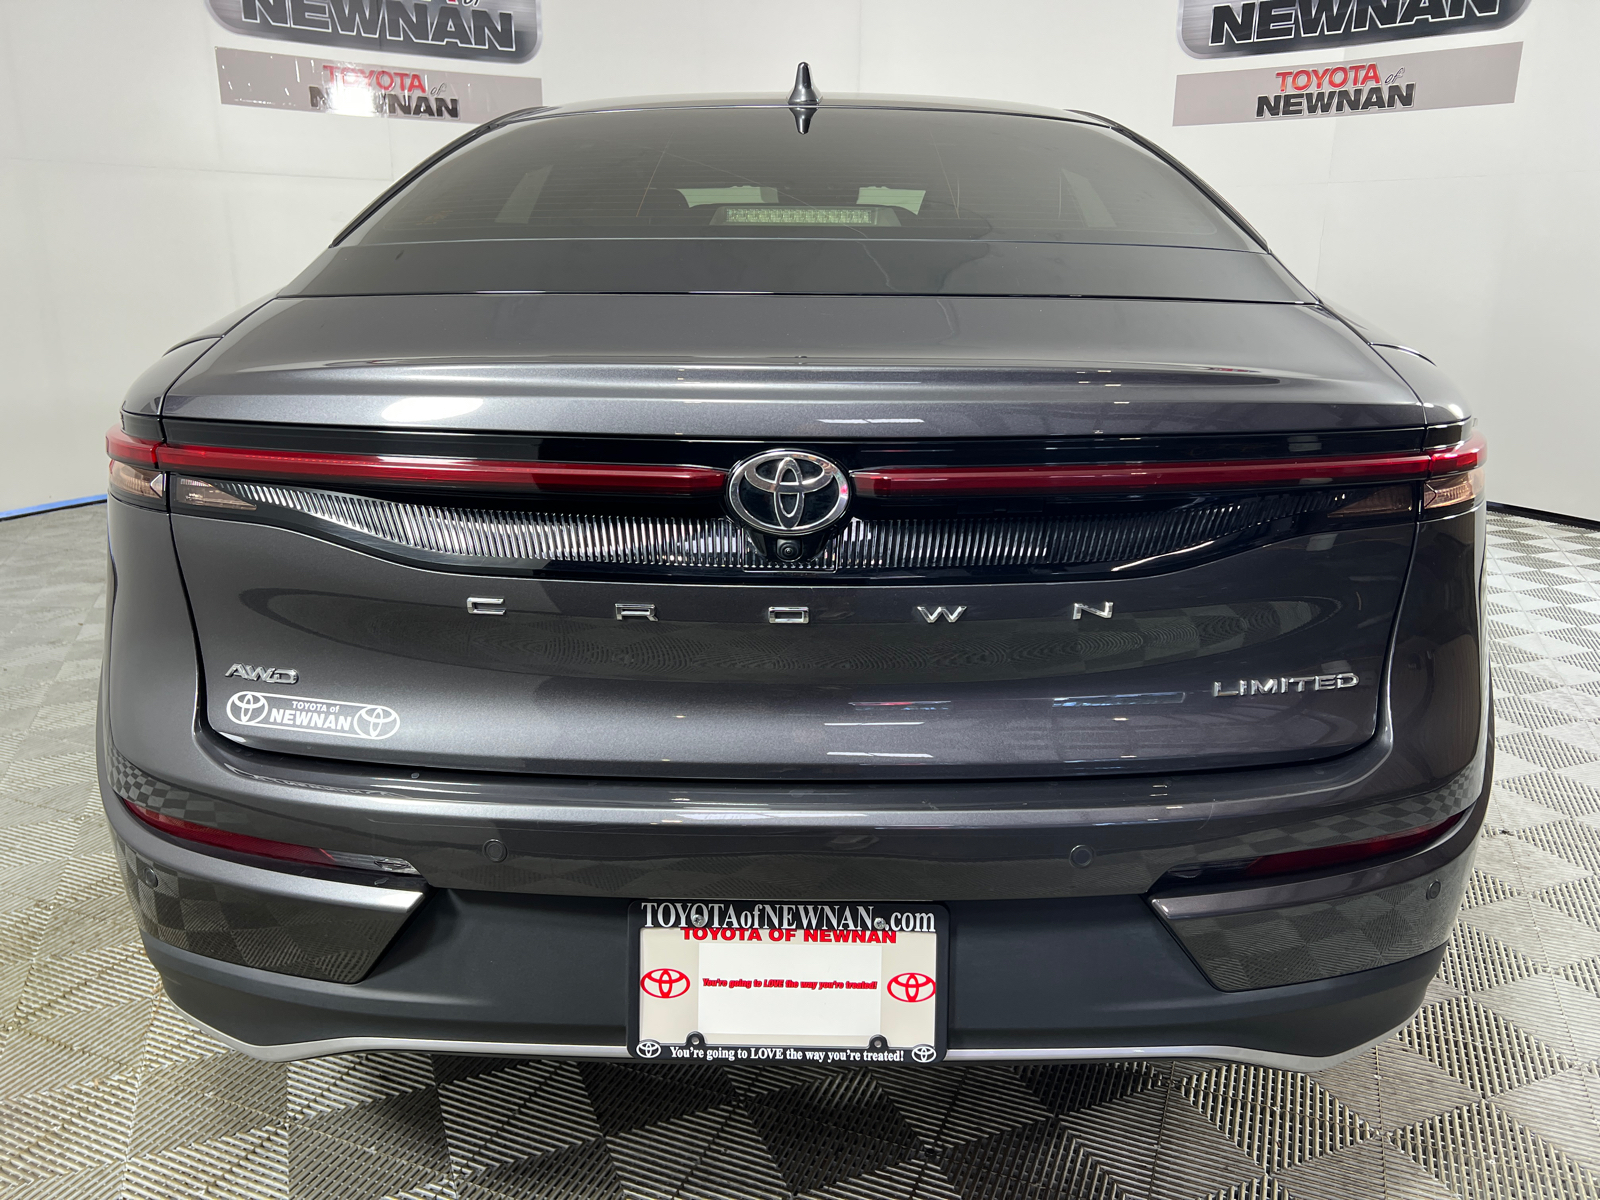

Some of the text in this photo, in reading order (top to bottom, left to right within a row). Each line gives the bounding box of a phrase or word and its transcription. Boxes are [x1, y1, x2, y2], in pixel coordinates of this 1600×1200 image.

[240, 0, 516, 51] NEWNAN
[322, 64, 427, 94] TOYOTA
[1275, 63, 1405, 92] TOYOTA of
[308, 86, 460, 119] NNAN
[1256, 82, 1416, 118] NEWNAN
[466, 596, 1113, 624] CROWN
[225, 663, 299, 684] AWD
[1213, 672, 1360, 697] LIMITED
[269, 708, 352, 731] NEWNAN
[291, 701, 340, 713] TOYOTA of
[680, 927, 897, 944] TOYOTA OF NEWNAN
[729, 979, 752, 989] going
[753, 979, 762, 987] to
[763, 979, 784, 988] LOVE
[785, 979, 799, 988] the
[800, 981, 817, 990] way
[845, 981, 878, 990] treated!
[706, 1048, 735, 1061] going
[737, 1049, 748, 1059] to
[750, 1048, 784, 1060] LOVE
[786, 1048, 803, 1060] the
[805, 1051, 825, 1062] way
[863, 1050, 904, 1062] treated!
